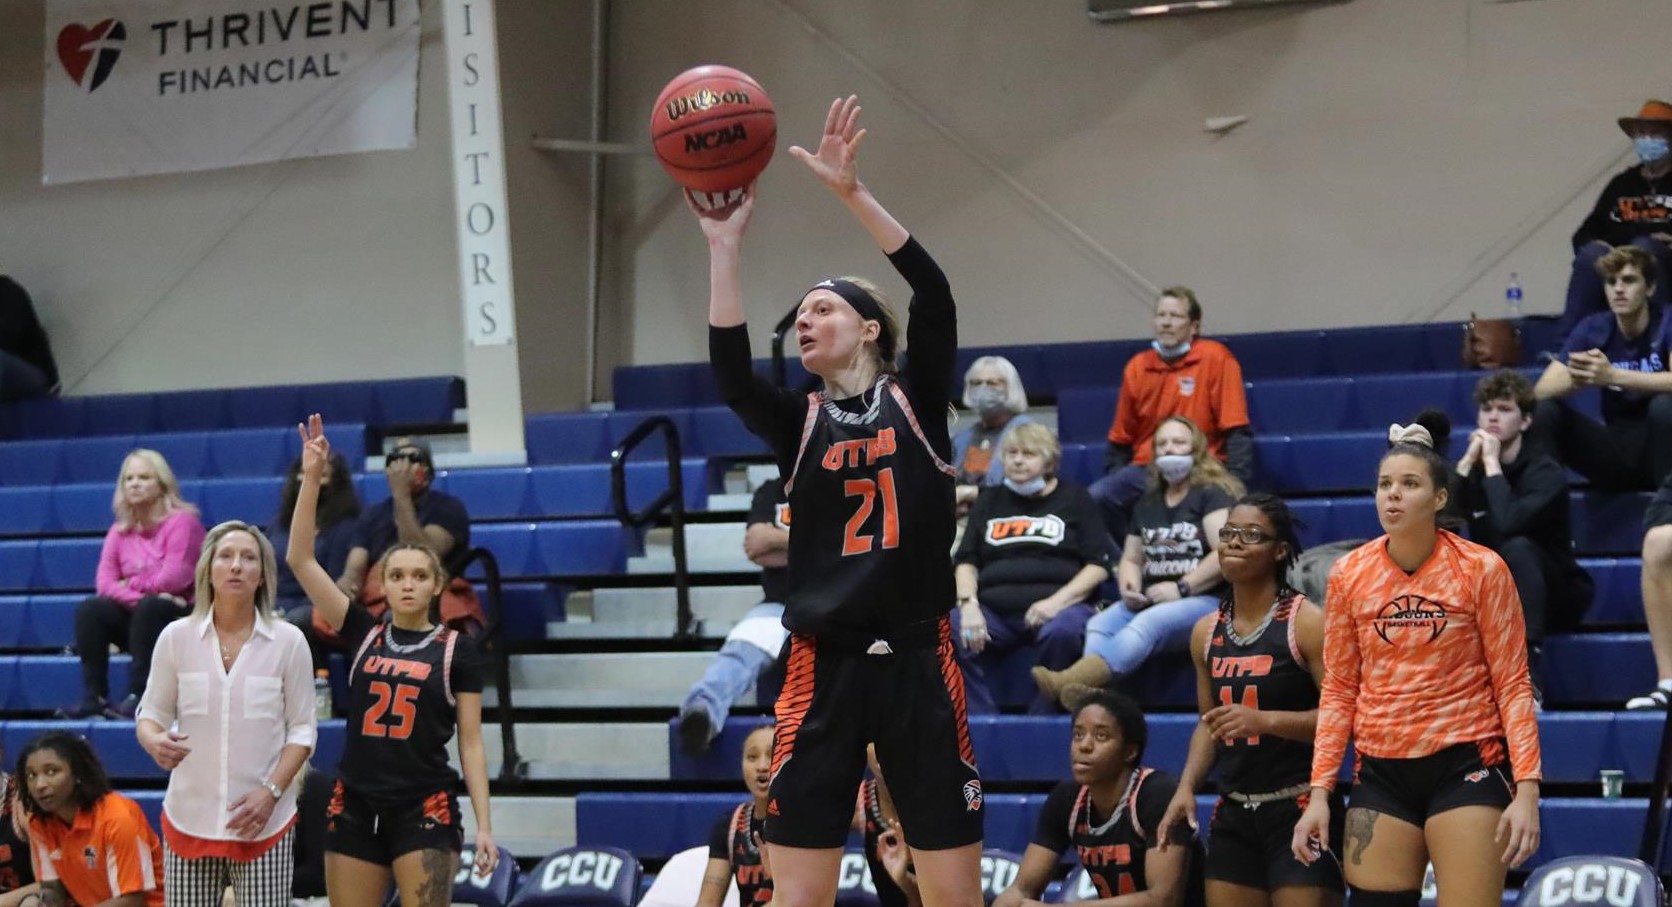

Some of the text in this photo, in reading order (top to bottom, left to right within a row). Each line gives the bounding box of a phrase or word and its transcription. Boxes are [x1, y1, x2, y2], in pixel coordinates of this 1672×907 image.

[151, 0, 397, 55] THRIVENT
[158, 53, 340, 96] FINANCIAL
[666, 87, 750, 121] Wilson
[684, 121, 747, 153] NCAA
[822, 426, 897, 471] UTPB
[841, 466, 900, 557] 21
[990, 518, 1061, 541] UTPB
[363, 655, 433, 681] UTPB
[1211, 654, 1274, 678] UTPB
[361, 680, 421, 740] 25
[454, 850, 499, 889] CU
[541, 850, 624, 892] CCU
[980, 856, 1020, 895] CU
[1539, 864, 1642, 907] CCU
